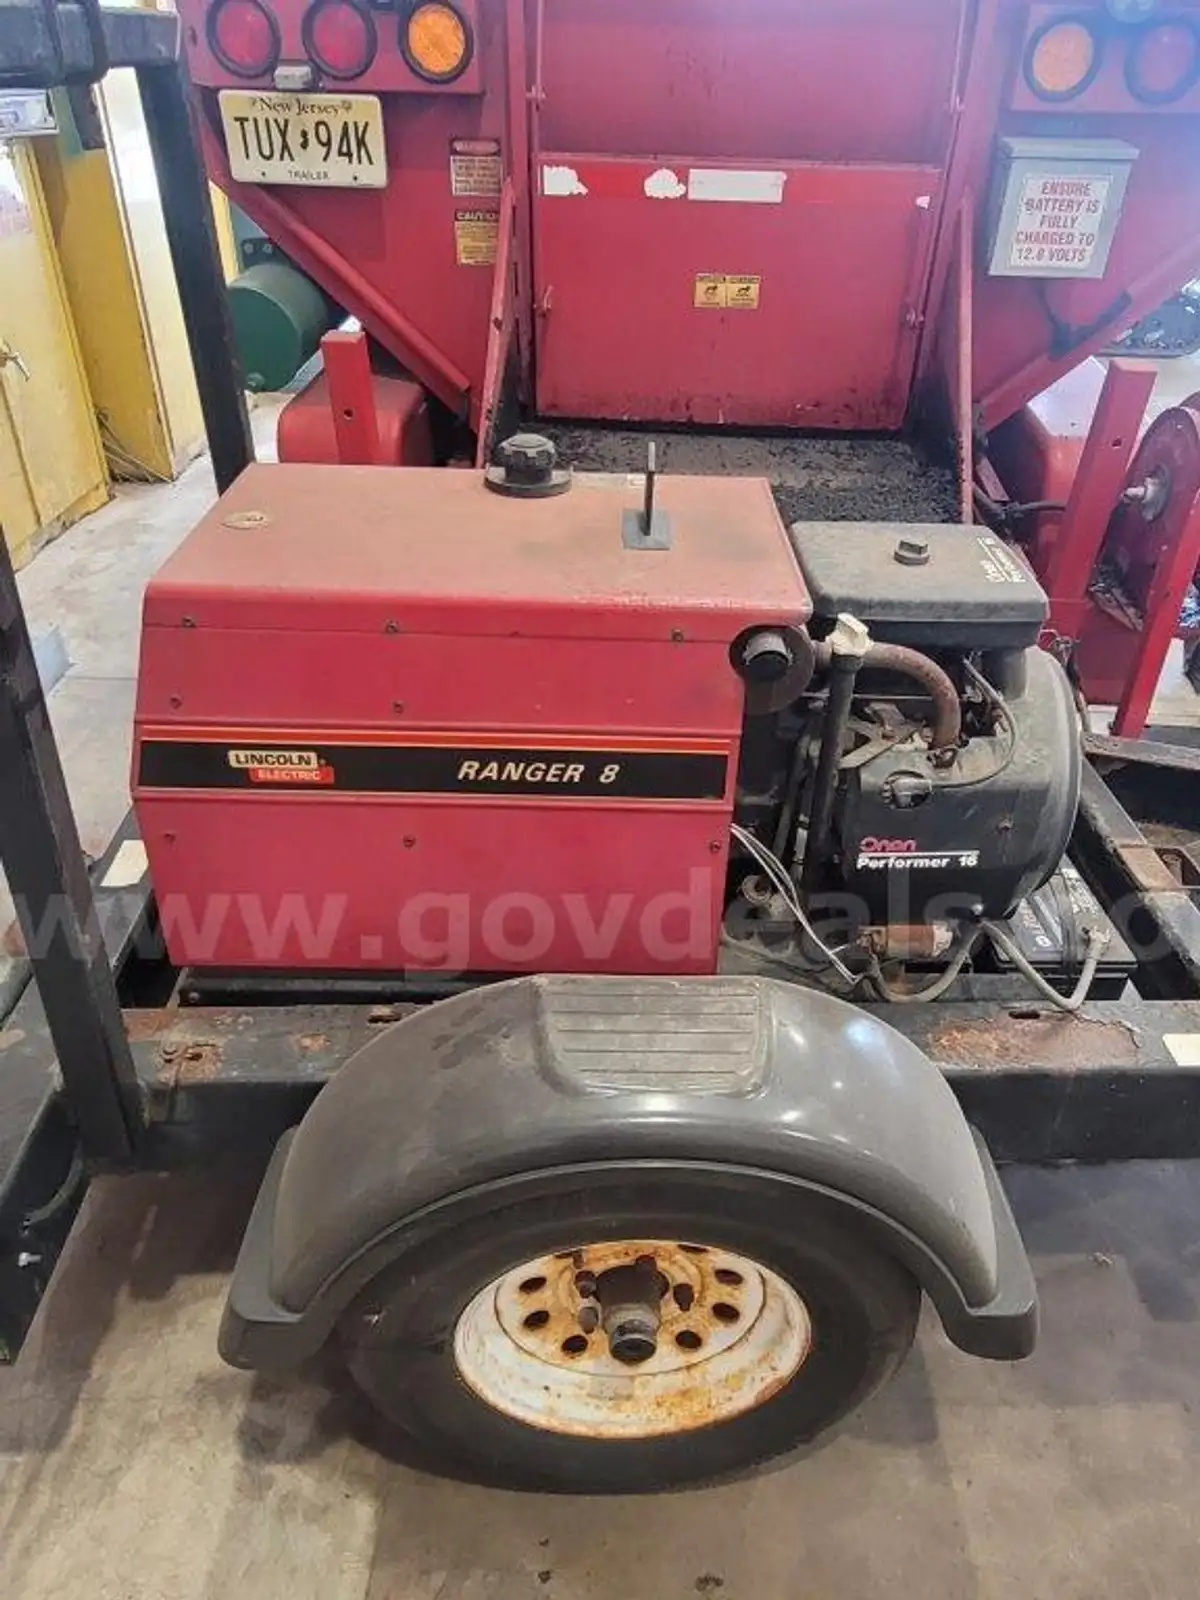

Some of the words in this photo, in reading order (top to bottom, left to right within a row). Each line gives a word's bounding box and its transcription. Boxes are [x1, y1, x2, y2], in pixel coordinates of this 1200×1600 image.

[259, 97, 292, 114] New
[296, 98, 339, 117] Jersey
[233, 116, 295, 162] TUX
[314, 120, 374, 166] 94K
[288, 169, 330, 181] TRAILER
[1041, 180, 1093, 195] ENSURE
[1024, 198, 1085, 213] BATTERY
[1086, 199, 1100, 214] IS
[1039, 214, 1079, 229] FULLY
[1014, 230, 1075, 246] CHARGED
[1078, 232, 1095, 247] TO
[1049, 248, 1087, 263] VOLTS
[234, 753, 312, 767] LINCOLN
[257, 767, 322, 781] ELECTRIC
[457, 760, 585, 783] RANGER
[599, 763, 620, 784] 8
[860, 836, 917, 852] Onan
[856, 855, 951, 870] Performer
